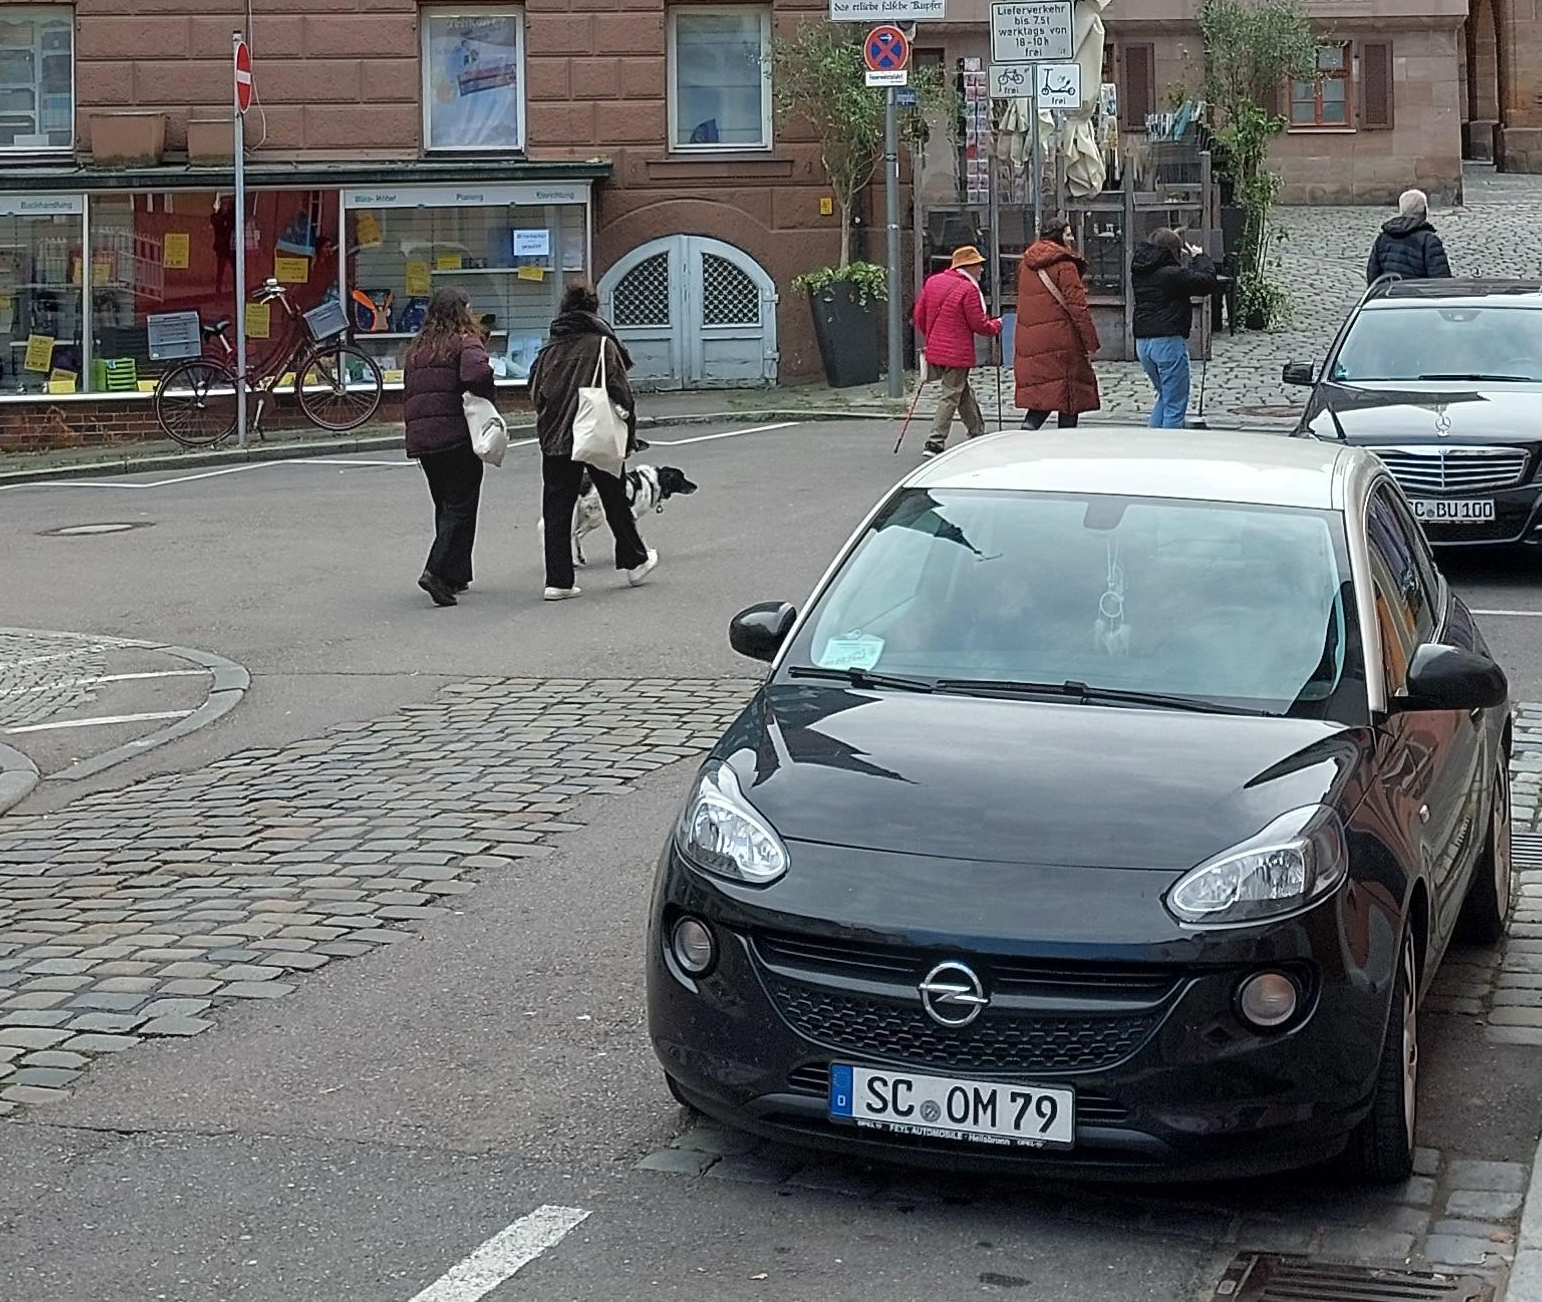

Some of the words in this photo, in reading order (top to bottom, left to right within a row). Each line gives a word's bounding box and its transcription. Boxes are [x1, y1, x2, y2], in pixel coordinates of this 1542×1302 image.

[997, 5, 1066, 16] Lieferverkehr
[1014, 17, 1028, 25] bis
[998, 27, 1045, 37] werktags
[1049, 27, 1067, 35] von
[1025, 48, 1042, 57] frei
[1004, 86, 1020, 95] frei
[1051, 96, 1066, 105] frei
[20, 201, 74, 210] Buchhandlung
[1436, 502, 1458, 518] BU
[1461, 502, 1493, 518] 100
[837, 1095, 846, 1107] D
[865, 1075, 915, 1118] SC
[946, 1085, 998, 1128] OM
[1010, 1091, 1058, 1134] 79
[889, 1123, 910, 1135] FEYL
[911, 1126, 963, 1141] AUTOMOBILE
[968, 1133, 1011, 1146] Heilsbronn
